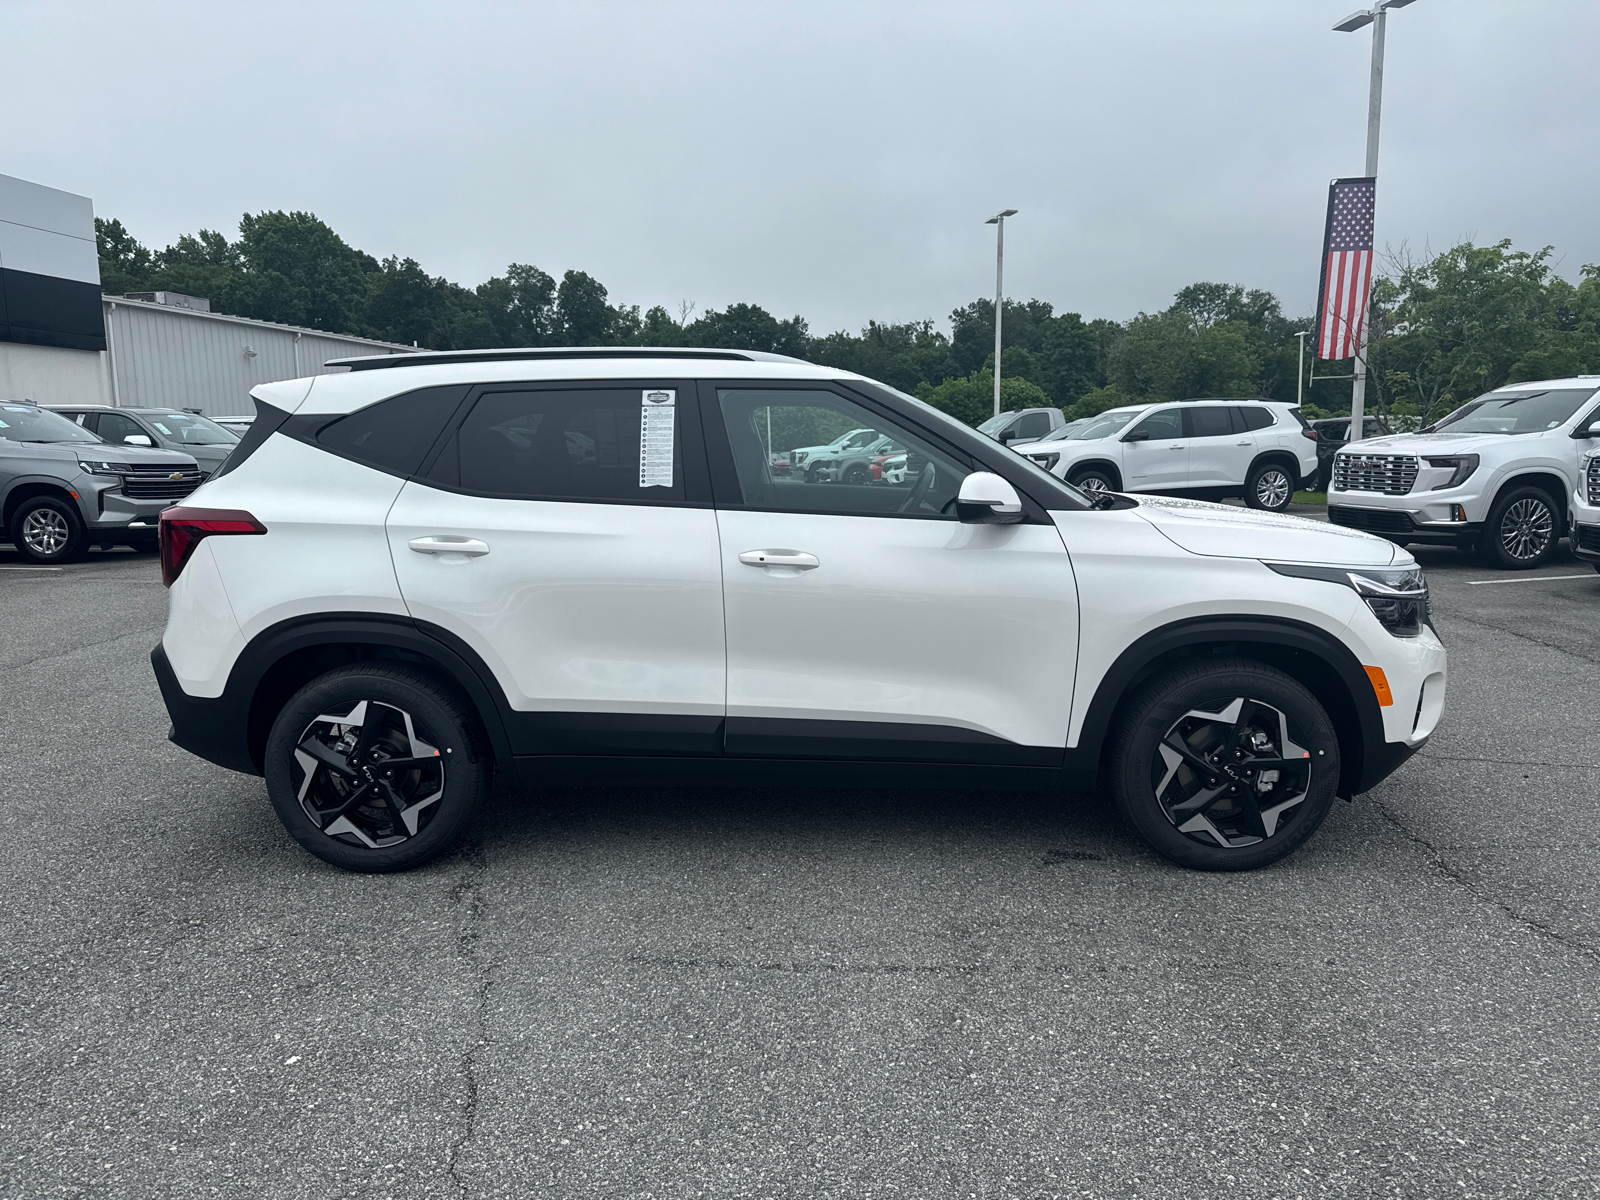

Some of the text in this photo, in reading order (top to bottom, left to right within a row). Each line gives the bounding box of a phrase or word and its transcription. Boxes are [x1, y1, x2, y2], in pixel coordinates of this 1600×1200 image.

[376, 682, 438, 721] KUMHO
[1221, 677, 1289, 698] KUMHO
[1266, 808, 1320, 858] SOLUS
